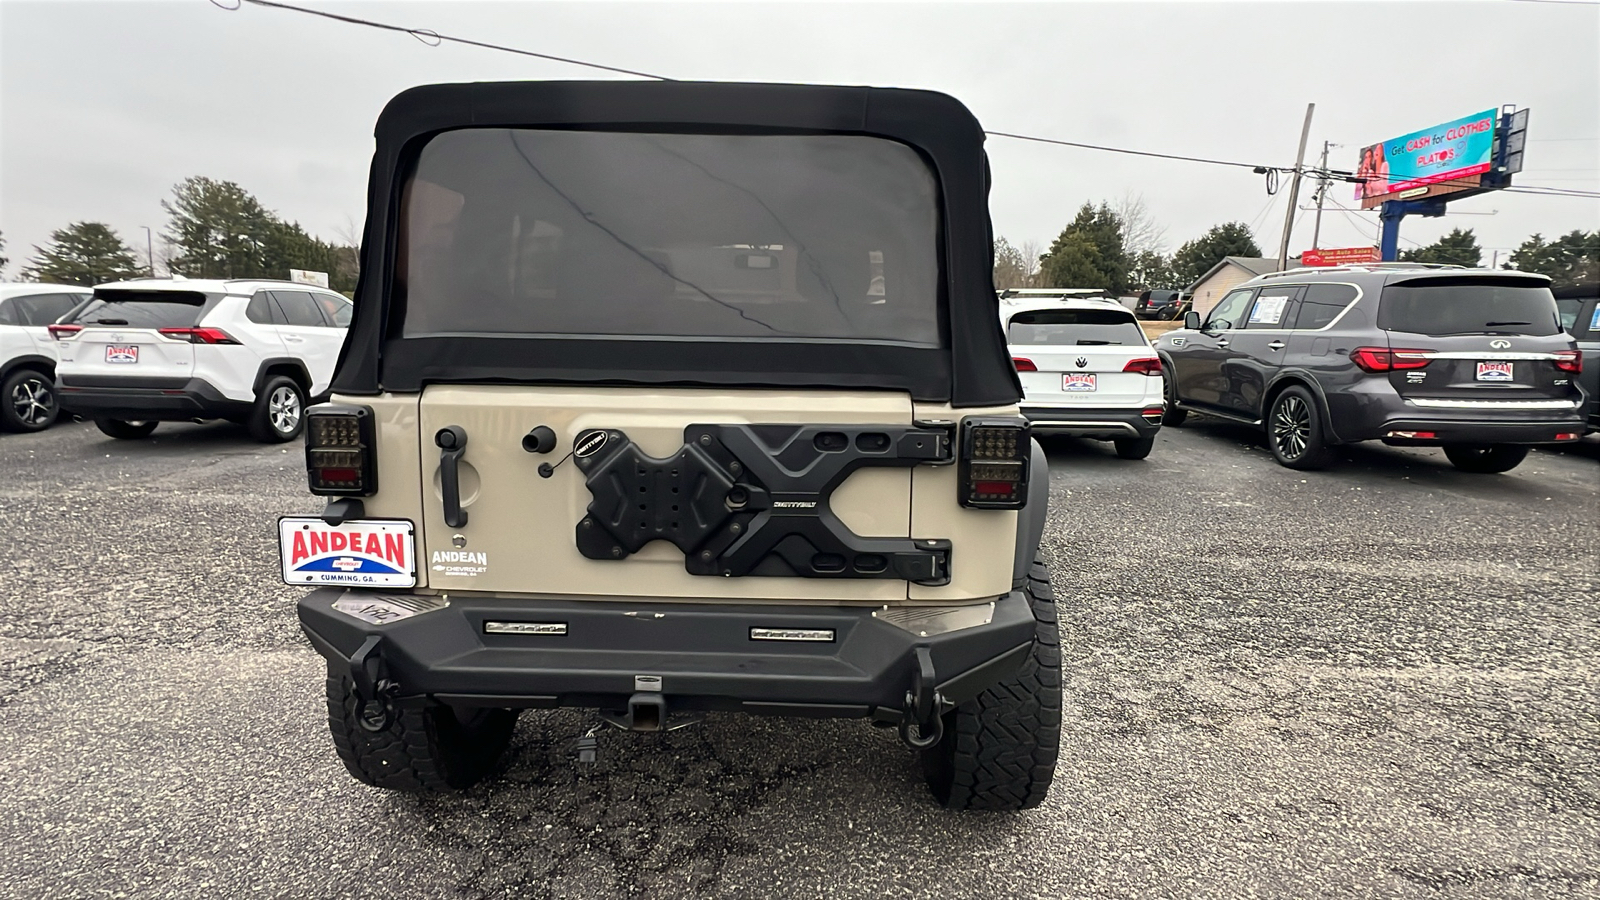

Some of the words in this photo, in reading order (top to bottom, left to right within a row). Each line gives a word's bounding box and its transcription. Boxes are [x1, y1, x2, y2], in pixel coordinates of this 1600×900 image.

[1391, 145, 1405, 156] Get
[1406, 136, 1431, 152] CASH
[1432, 134, 1445, 145] for
[1446, 117, 1492, 141] CLOTHES
[1479, 364, 1512, 374] ANDEAN
[291, 530, 406, 569] ANDEAN
[431, 550, 488, 566] ANDEAN
[320, 574, 361, 583] CUMMING,
[362, 575, 377, 583] GA.
